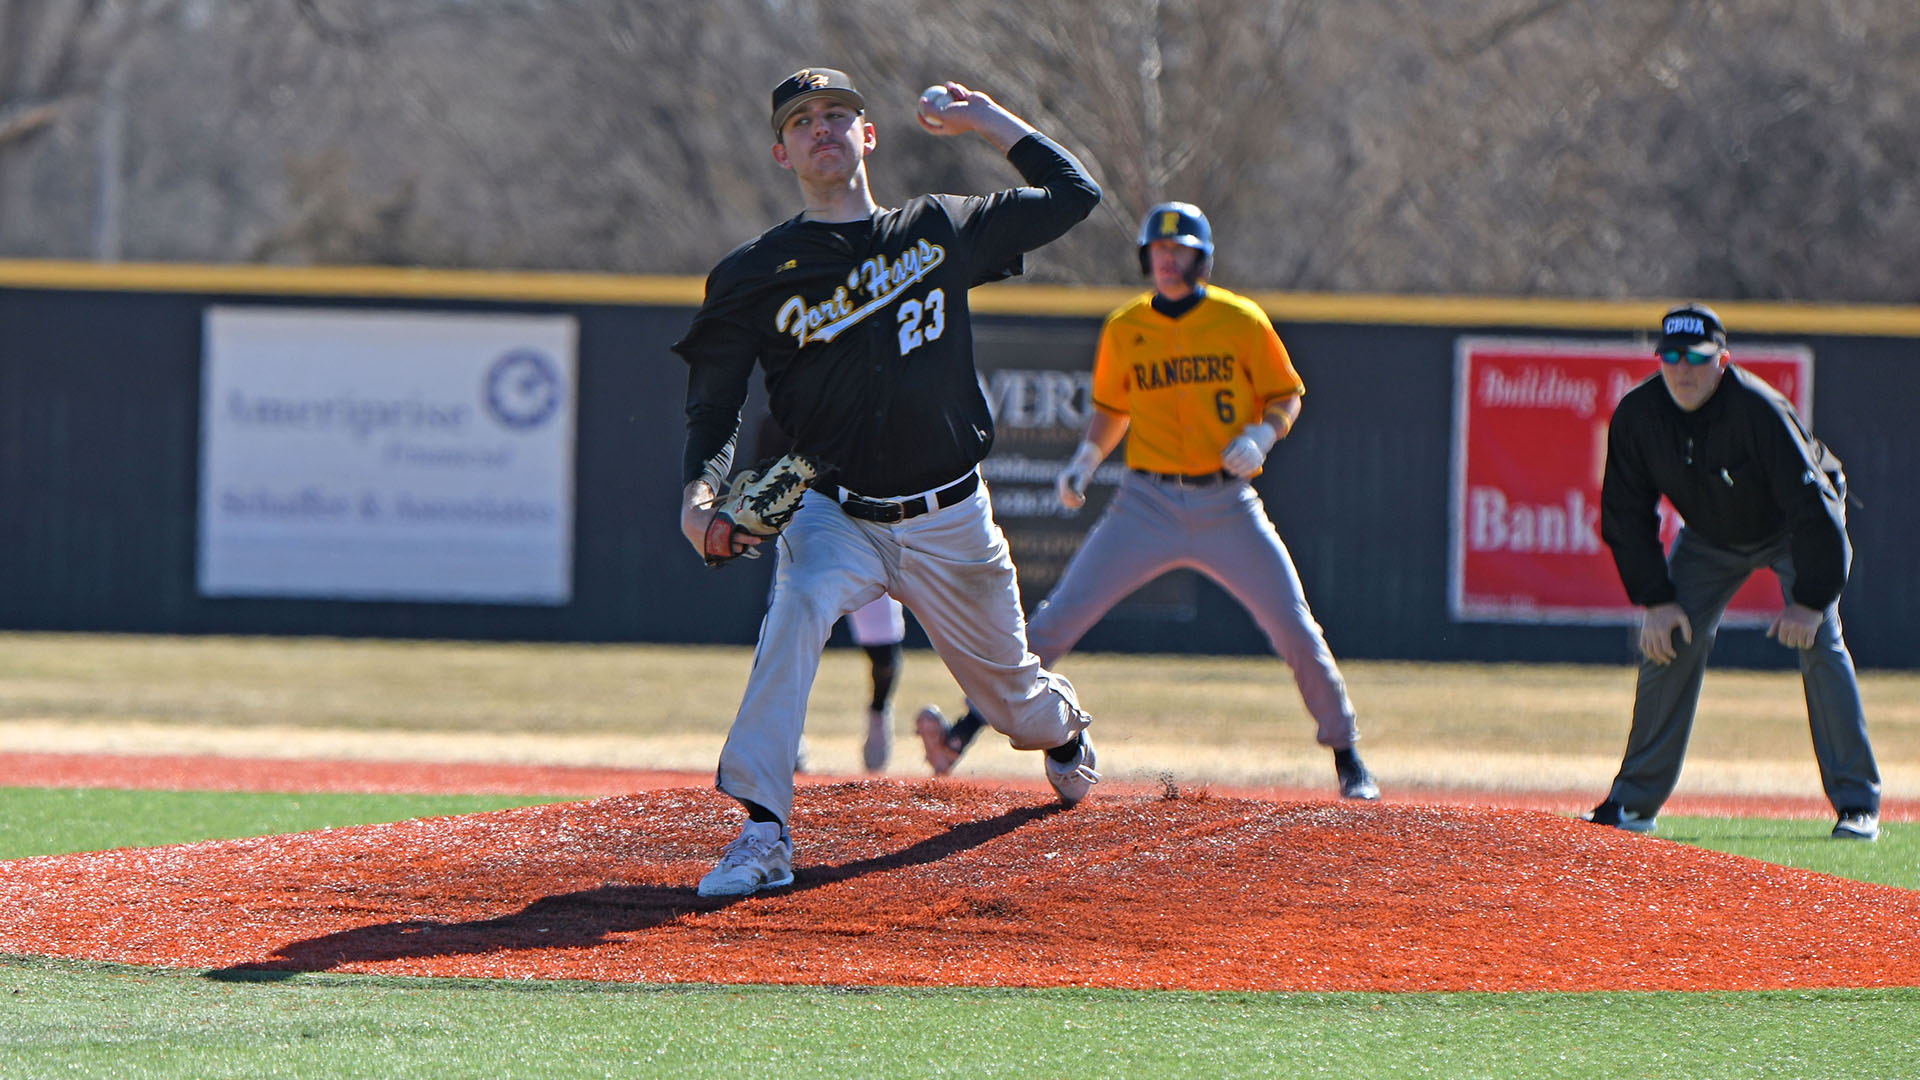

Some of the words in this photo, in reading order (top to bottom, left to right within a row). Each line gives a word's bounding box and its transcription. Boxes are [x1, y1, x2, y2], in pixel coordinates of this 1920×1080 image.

[775, 286, 854, 348] Fort
[848, 238, 945, 299] Hays
[897, 288, 945, 356] 23
[1664, 315, 1705, 336] CBUA
[1133, 354, 1236, 391] RANGERS
[1479, 365, 1597, 418] Building
[1215, 389, 1236, 424] 6
[1469, 487, 1601, 554] Bank
